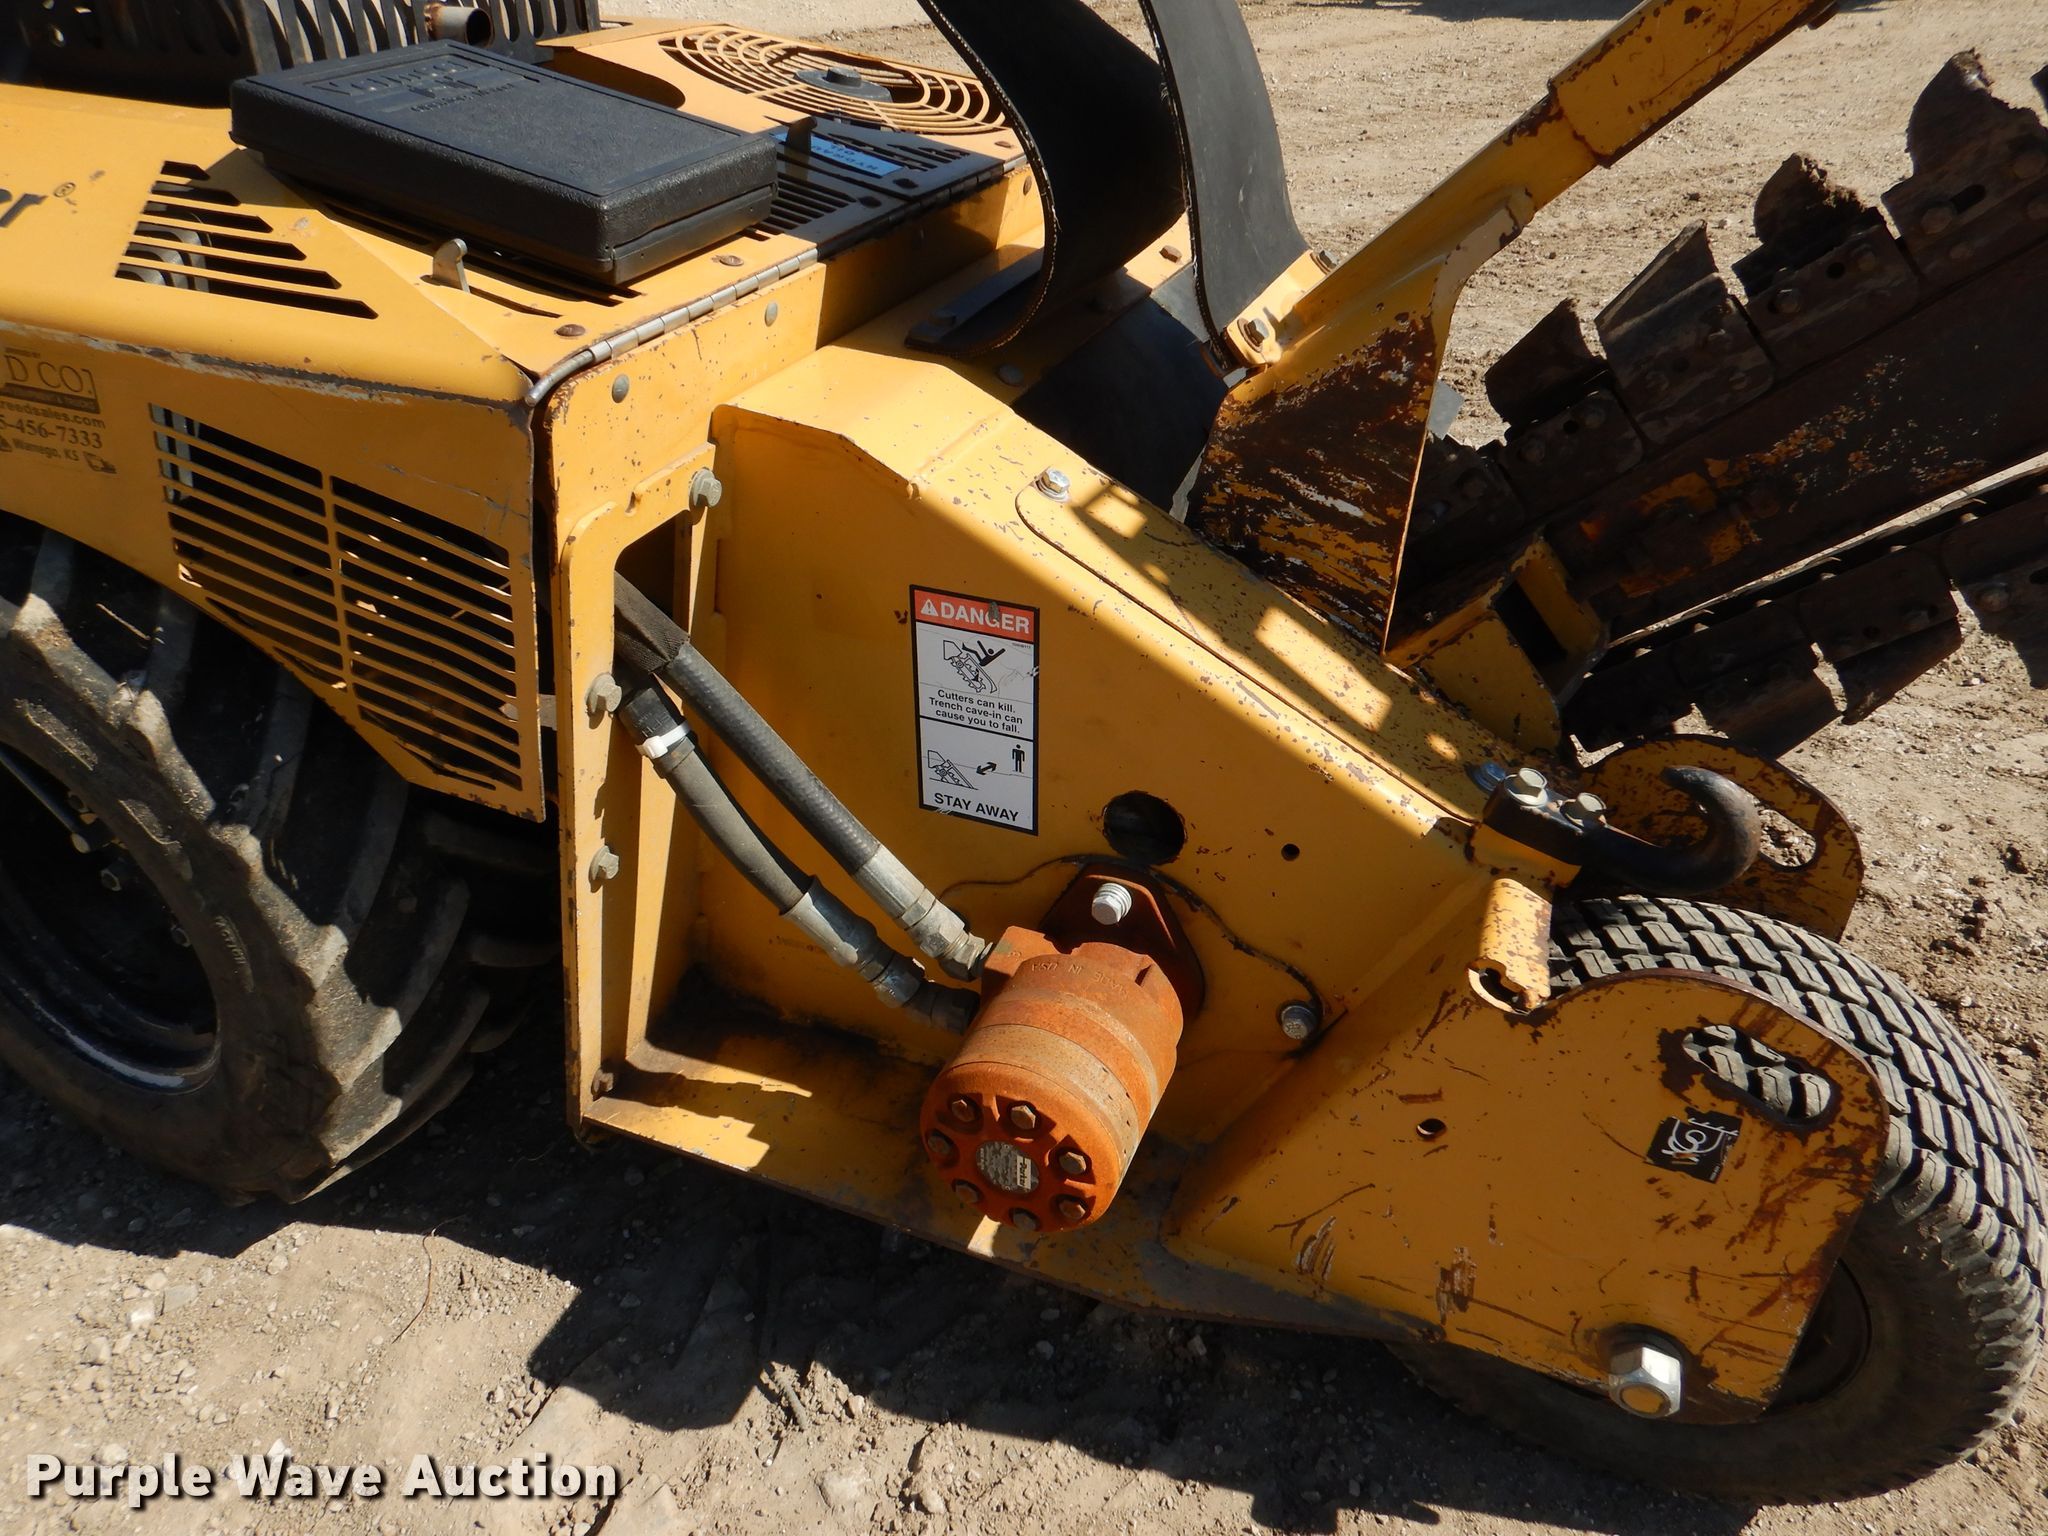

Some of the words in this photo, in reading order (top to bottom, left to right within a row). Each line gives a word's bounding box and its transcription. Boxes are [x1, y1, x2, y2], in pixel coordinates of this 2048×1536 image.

[940, 601, 1031, 635] DANGER
[929, 696, 963, 712] Trench
[965, 705, 1002, 720] cave-in
[1004, 713, 1024, 725] can
[937, 689, 974, 705] Cutters
[976, 698, 996, 709] can
[998, 700, 1016, 713] kill.
[935, 709, 966, 721] cause
[967, 715, 987, 728] you
[988, 718, 1000, 729] to
[1001, 718, 1021, 734] fall.
[933, 792, 972, 811] STAY
[975, 801, 1020, 822] AWAY
